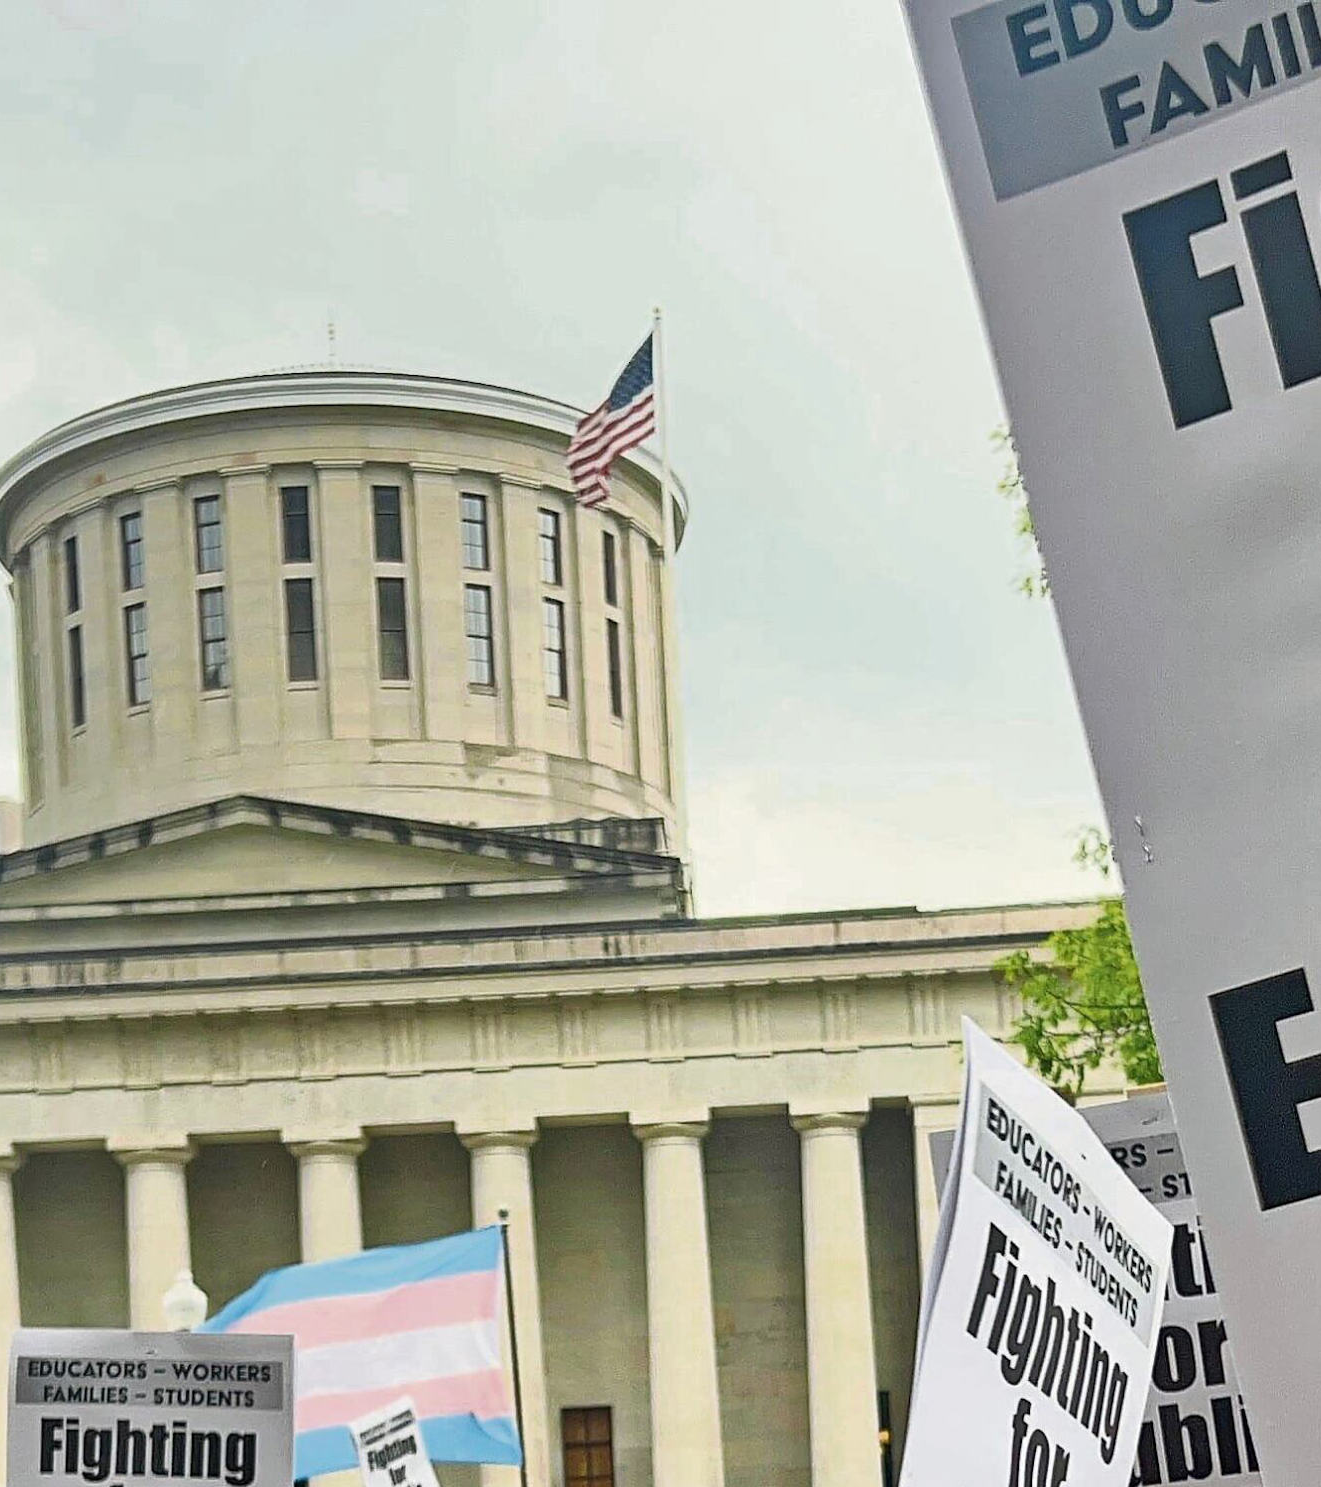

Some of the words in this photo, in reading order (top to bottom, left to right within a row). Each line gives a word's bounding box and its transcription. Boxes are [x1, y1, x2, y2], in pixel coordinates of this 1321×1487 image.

[987, 1098, 1082, 1216] EDUCATORS
[1093, 1205, 1153, 1294] WORKERS
[995, 1160, 1063, 1250] FAMILIES
[1075, 1241, 1139, 1328] STUDENTS
[26, 1360, 148, 1379] EDUCATORS
[172, 1362, 272, 1383] WORKERS
[43, 1385, 129, 1404] FAMILIES
[153, 1388, 255, 1408] STUDENTS
[966, 1222, 1128, 1465] Fighting
[39, 1417, 257, 1487] Fighting
